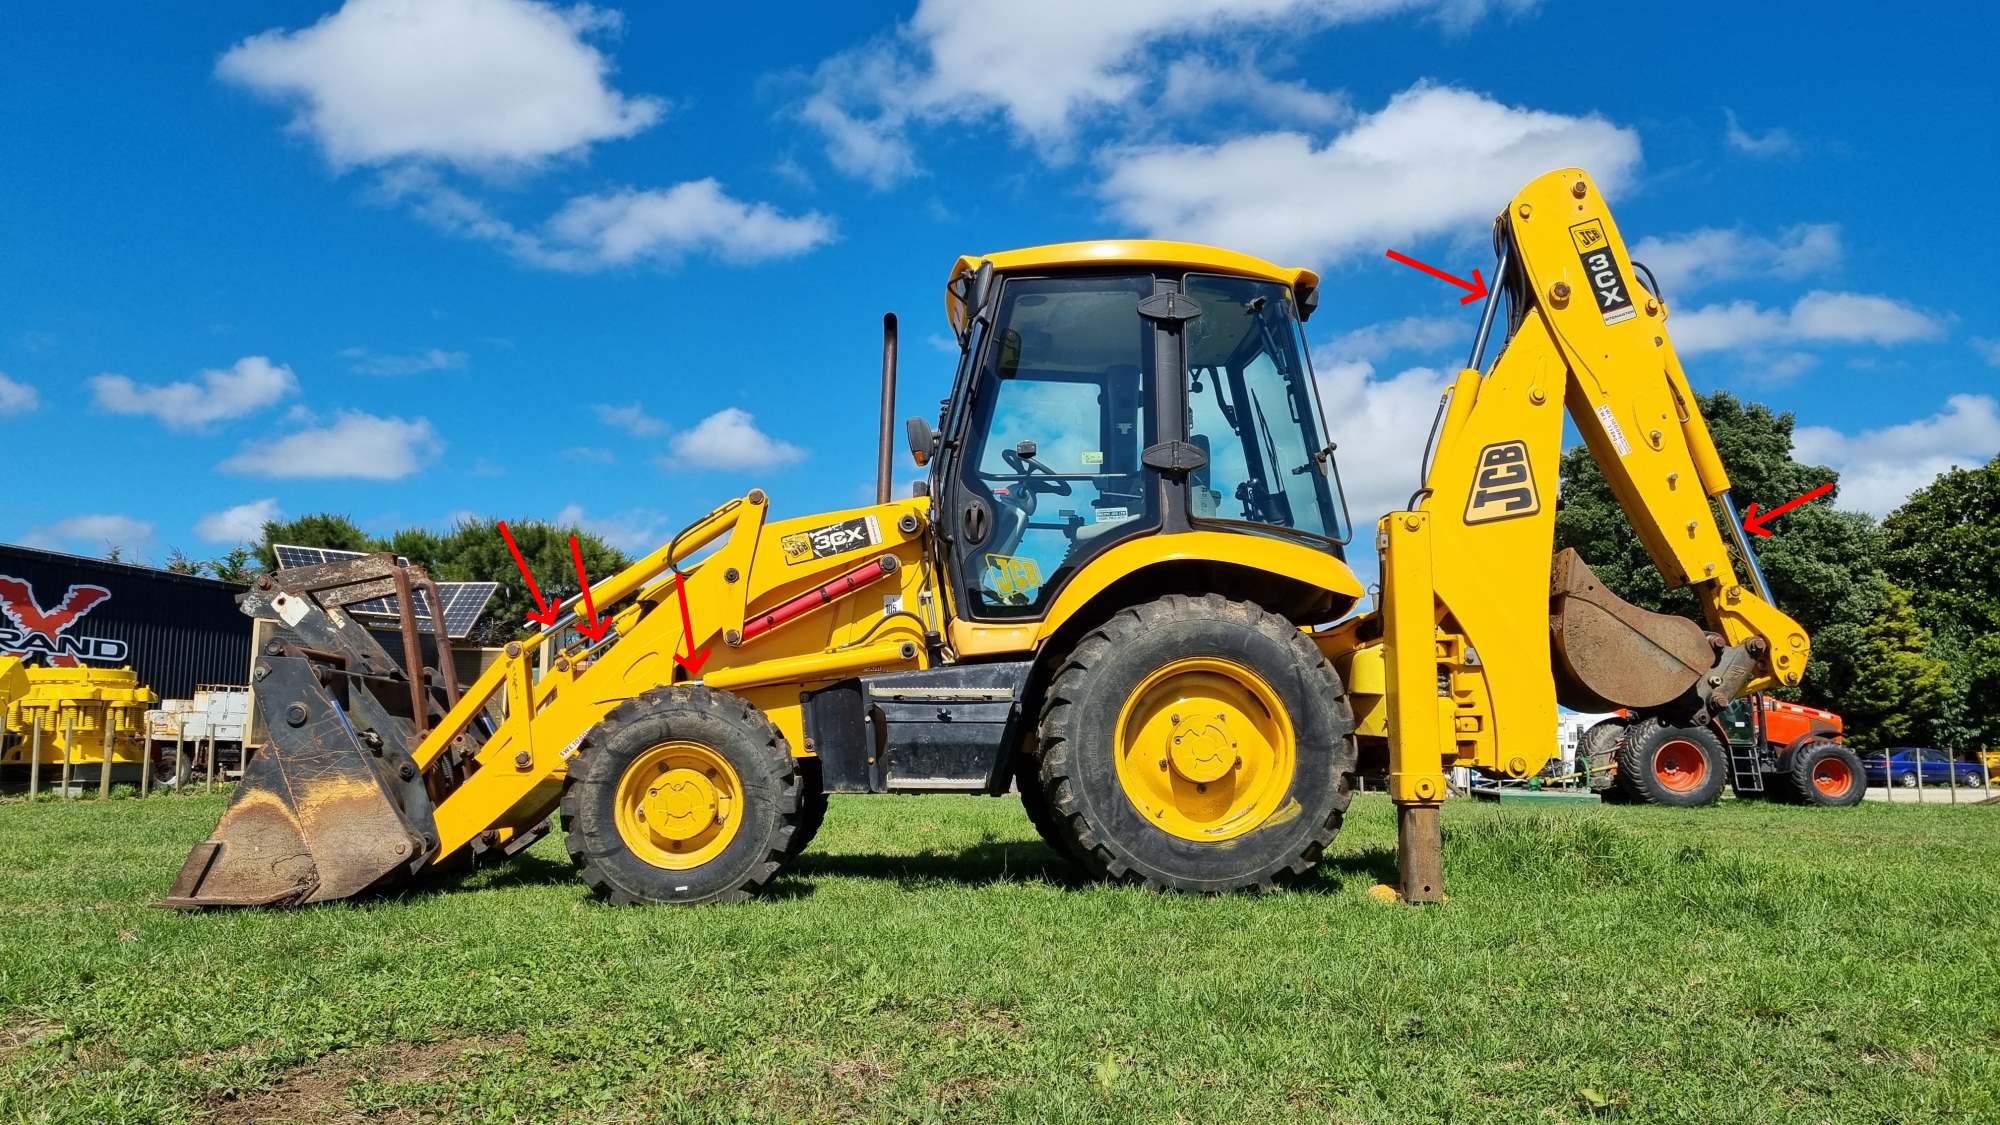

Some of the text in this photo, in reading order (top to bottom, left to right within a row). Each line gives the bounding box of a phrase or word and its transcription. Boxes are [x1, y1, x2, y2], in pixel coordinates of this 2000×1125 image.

[1578, 230, 1600, 246] JCB
[1589, 254, 1624, 306] 3CX
[1473, 446, 1532, 511] JCB
